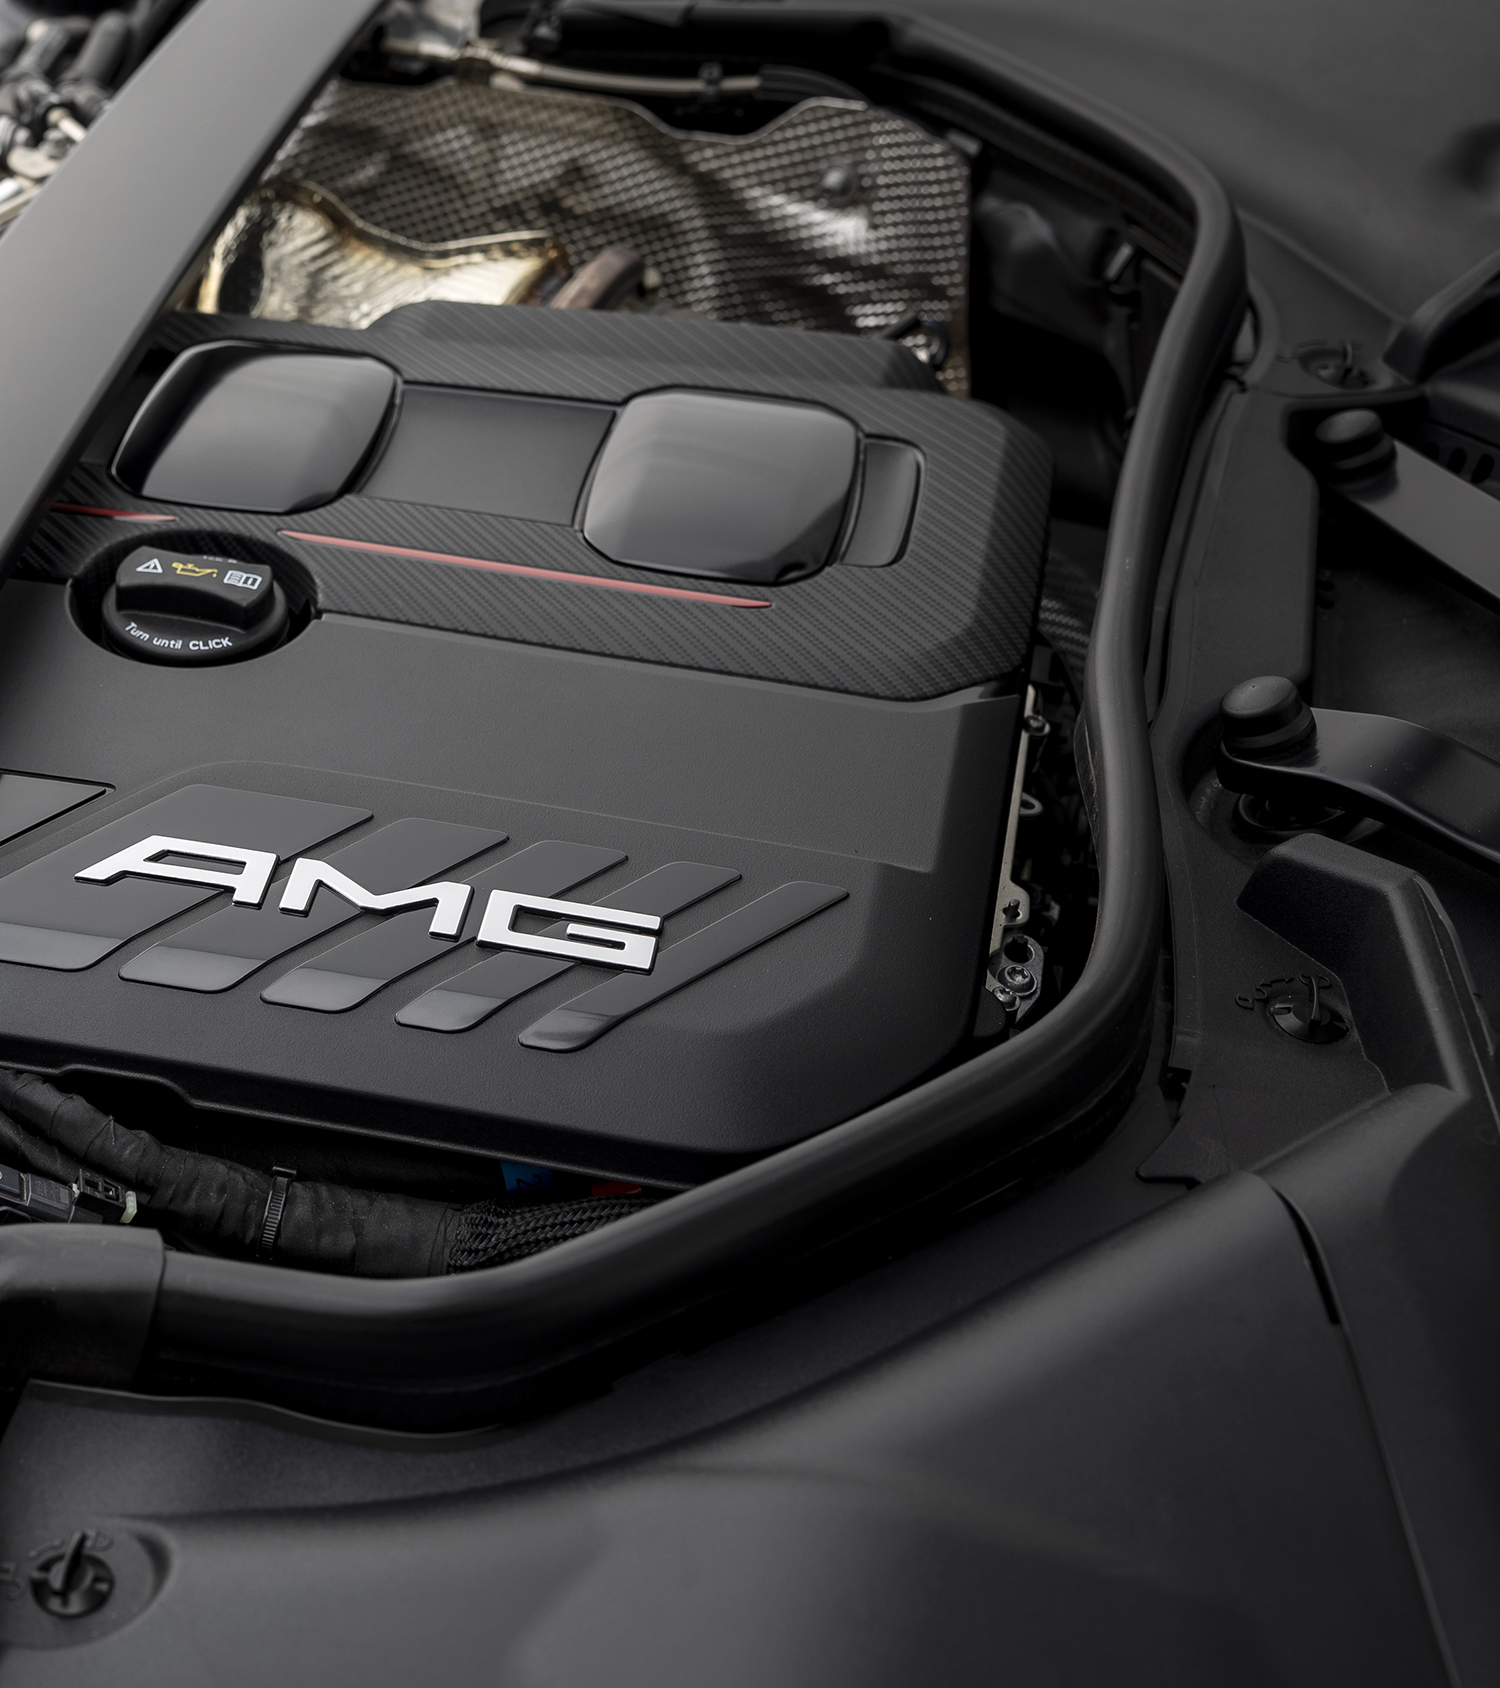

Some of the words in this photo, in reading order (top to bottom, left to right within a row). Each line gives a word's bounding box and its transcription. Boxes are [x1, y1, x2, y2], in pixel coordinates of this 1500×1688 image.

[124, 622, 151, 642] Turn
[153, 636, 183, 650] until
[189, 636, 234, 651] CLICK
[74, 834, 665, 975] AMG
